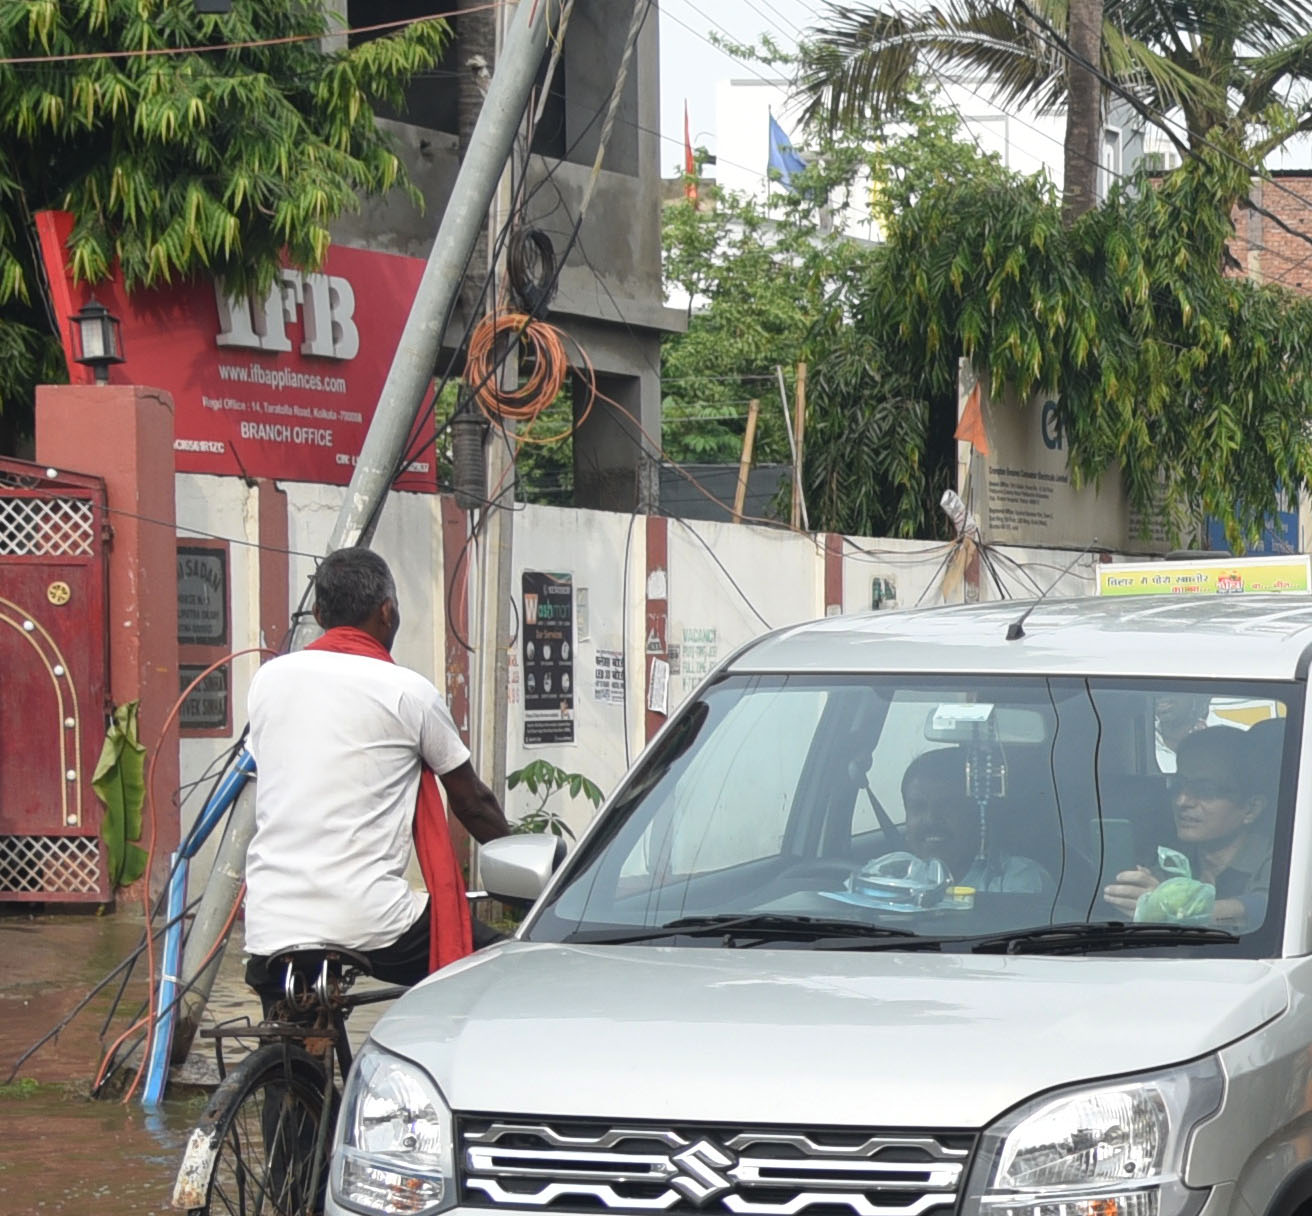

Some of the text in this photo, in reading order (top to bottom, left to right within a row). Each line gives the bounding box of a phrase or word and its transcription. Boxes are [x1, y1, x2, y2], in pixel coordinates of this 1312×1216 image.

[213, 268, 359, 360] IFB
[218, 363, 346, 393] www.ifbappliances.com
[240, 421, 333, 447] BRANCH OFFICE
